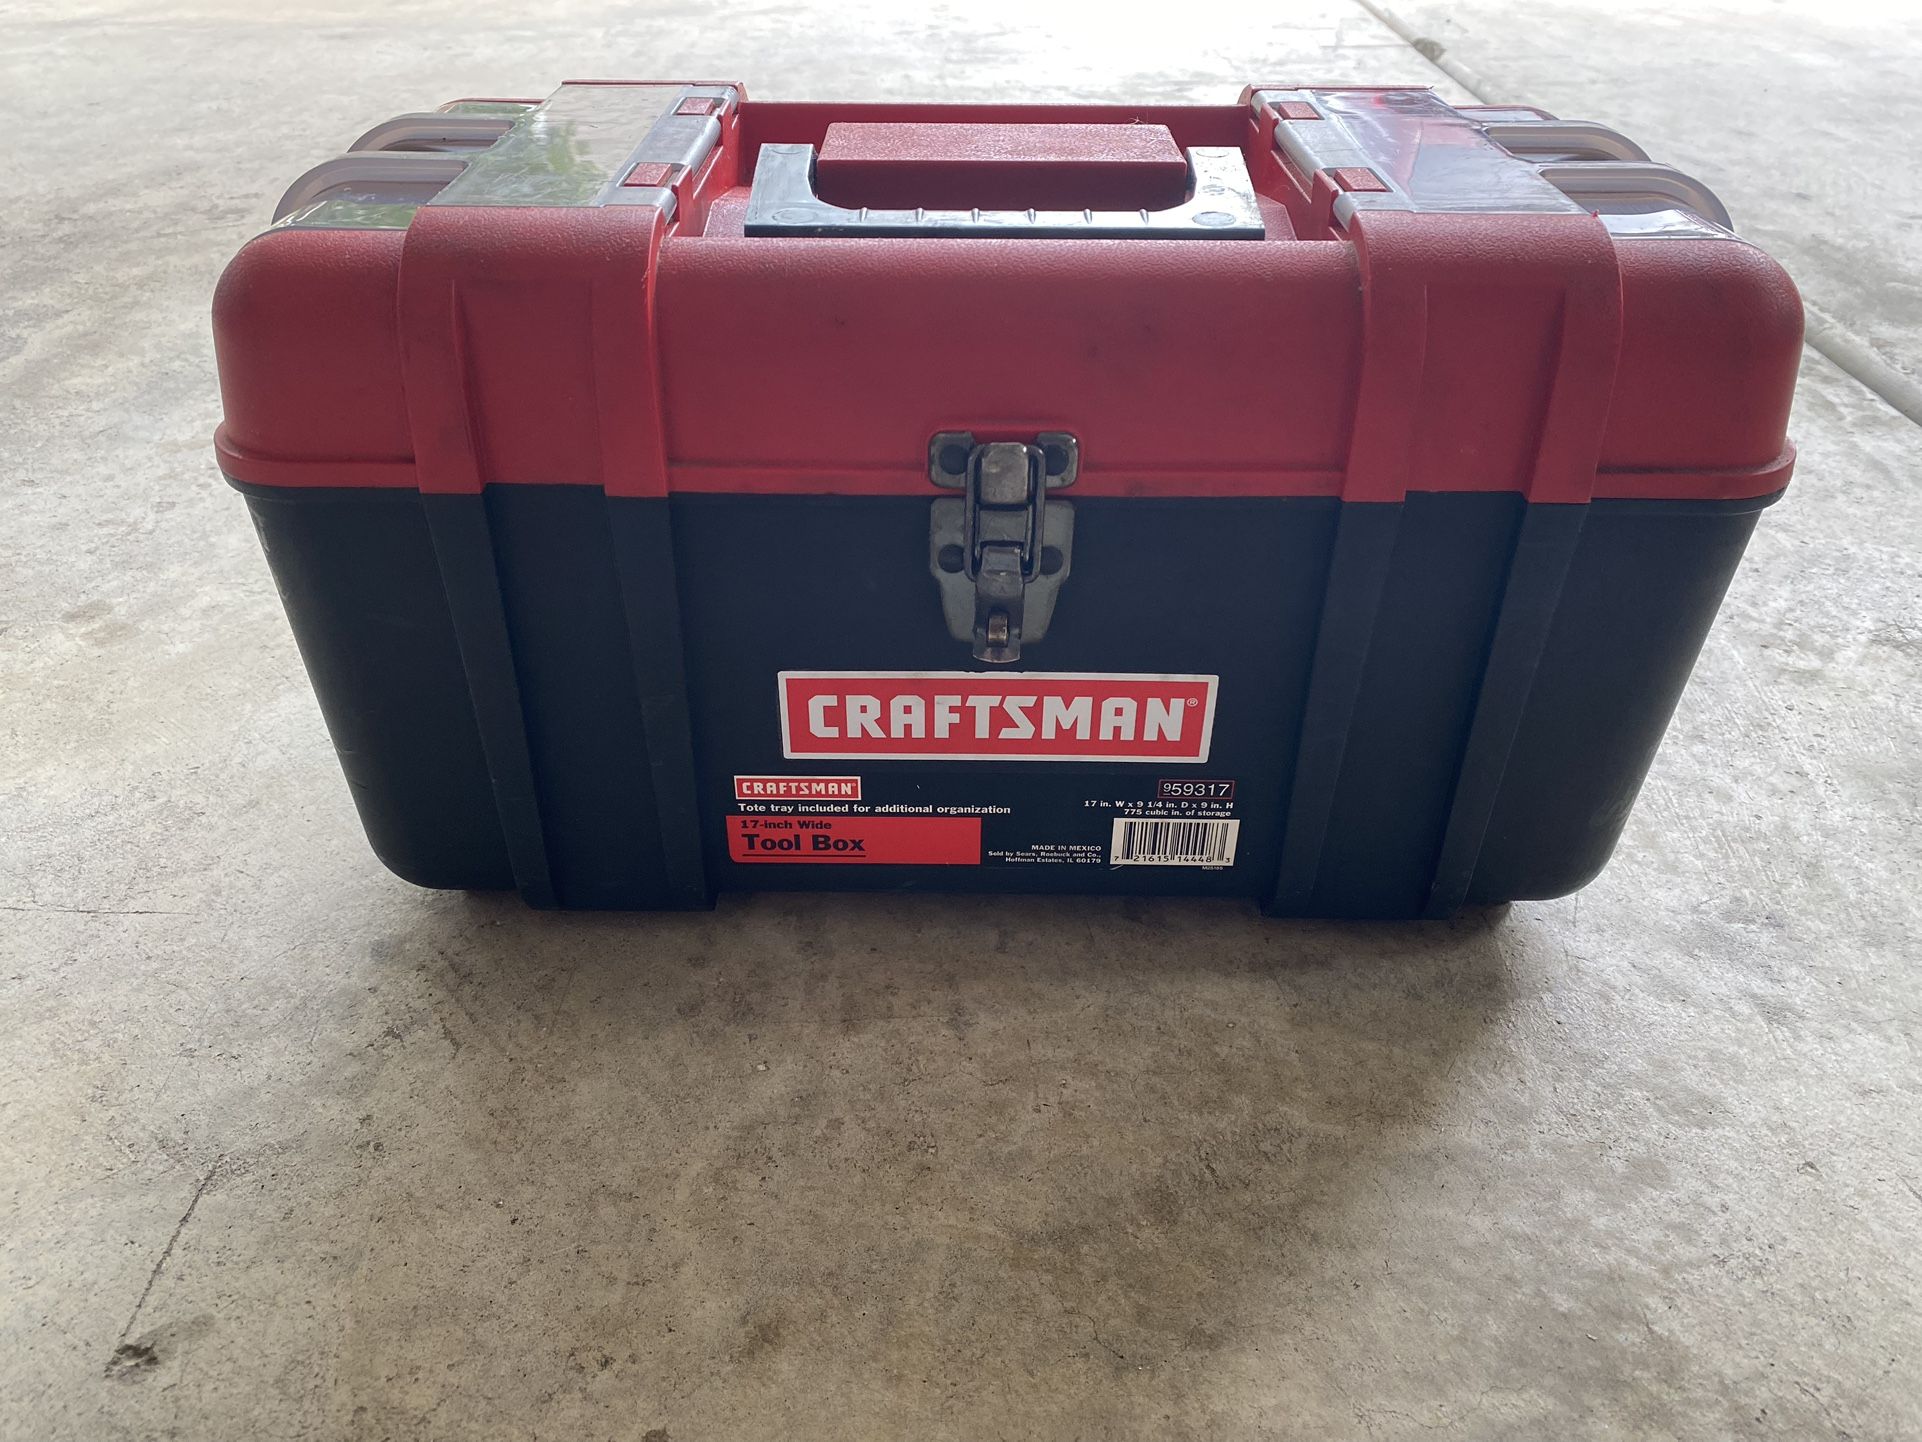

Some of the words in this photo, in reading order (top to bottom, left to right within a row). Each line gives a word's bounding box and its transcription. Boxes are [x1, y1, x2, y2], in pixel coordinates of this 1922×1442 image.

[1163, 782, 1230, 796] 959317
[738, 803, 766, 812] Tote
[771, 804, 794, 814] tray
[798, 803, 849, 813] included
[853, 803, 871, 813] for
[874, 804, 933, 813] additional
[937, 805, 1011, 814] organization
[1115, 800, 1125, 808] W
[1166, 801, 1177, 809] in.
[1197, 810, 1231, 818] storage
[741, 820, 793, 829] 17-inch
[797, 820, 832, 830] Wide
[741, 834, 801, 851] Tool
[812, 834, 866, 852] Box
